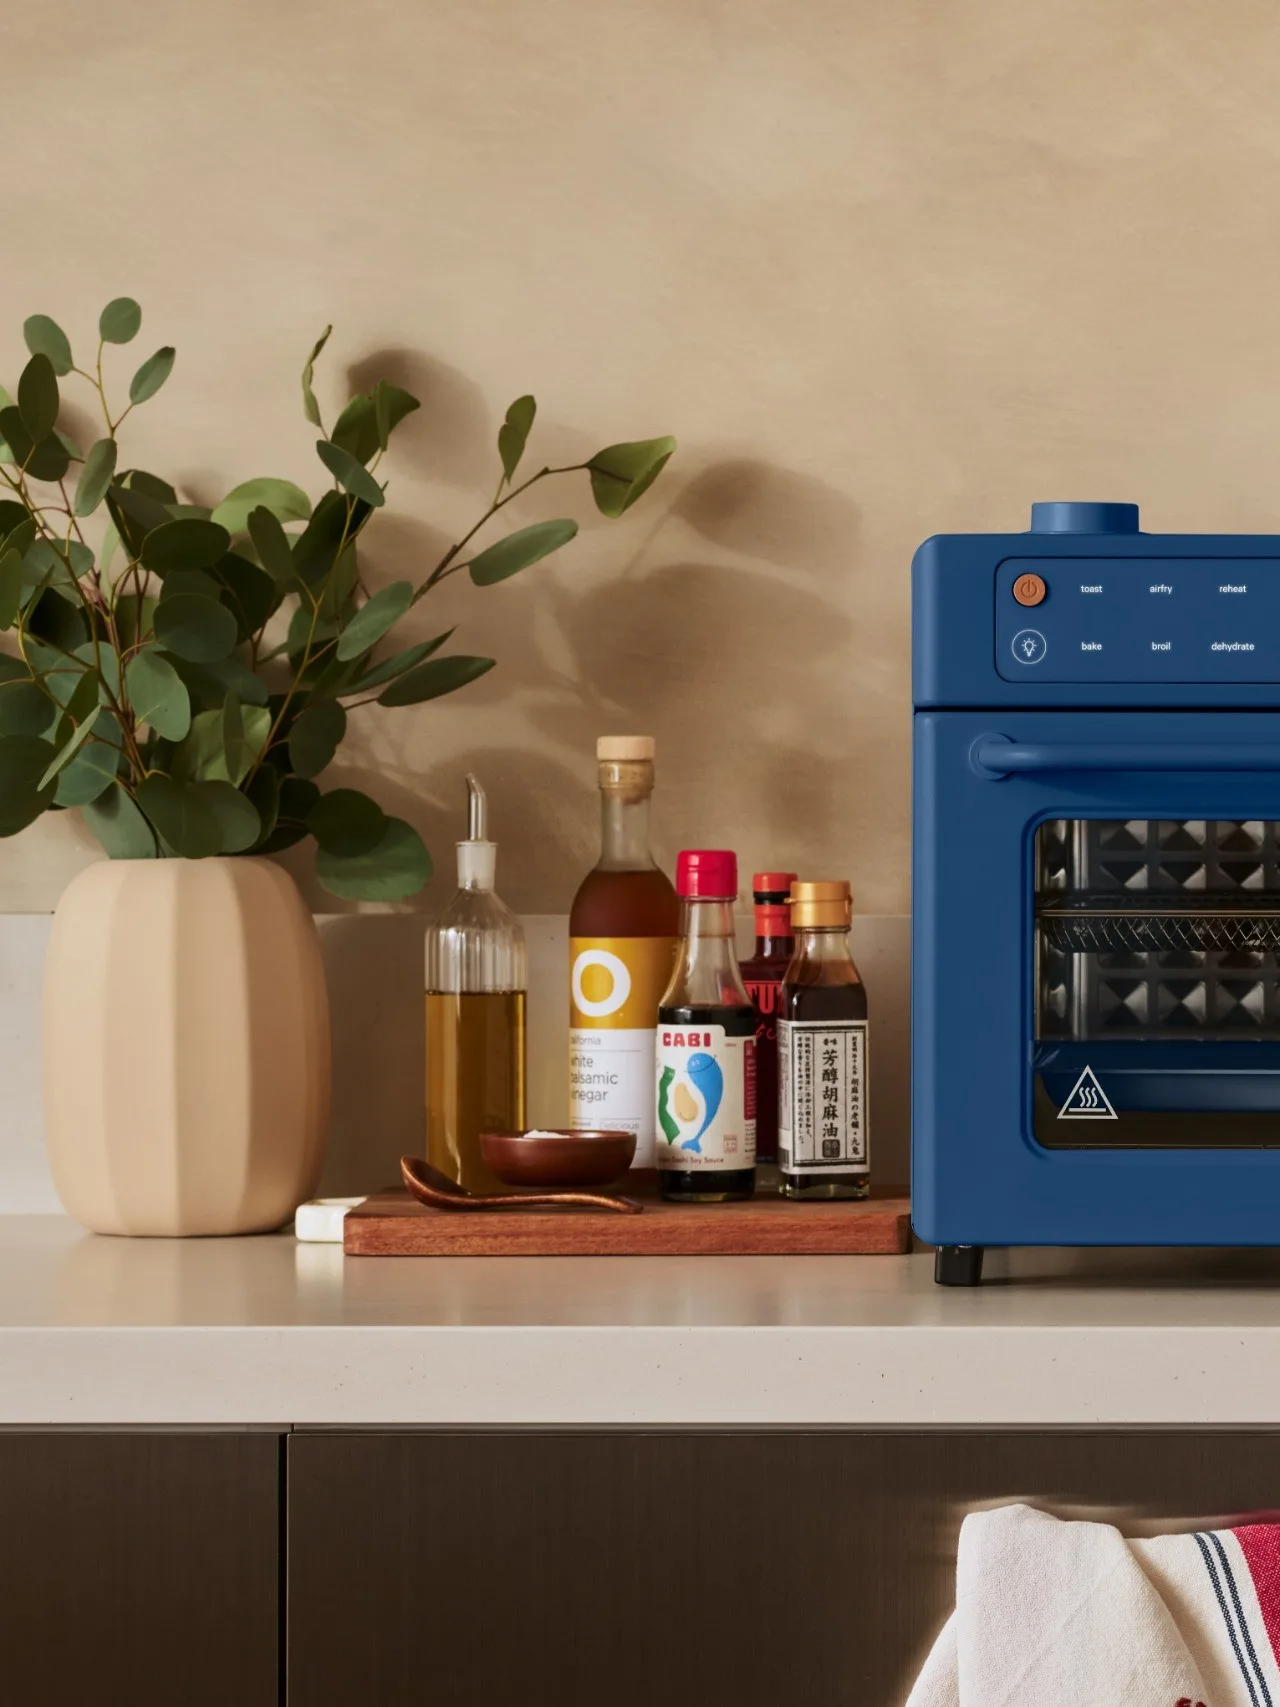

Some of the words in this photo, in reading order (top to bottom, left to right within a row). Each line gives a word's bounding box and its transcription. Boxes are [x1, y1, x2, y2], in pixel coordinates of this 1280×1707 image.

[1080, 584, 1103, 593] toast
[1149, 583, 1173, 595] airfry
[1219, 584, 1247, 593] reheat
[1081, 641, 1103, 651] bake
[1151, 641, 1171, 651] broil
[1210, 641, 1255, 654] dehydrate
[662, 1032, 712, 1047] CABI
[822, 1049, 839, 1138] 芳醇胡麻油
[704, 1155, 724, 1163] Sauce
